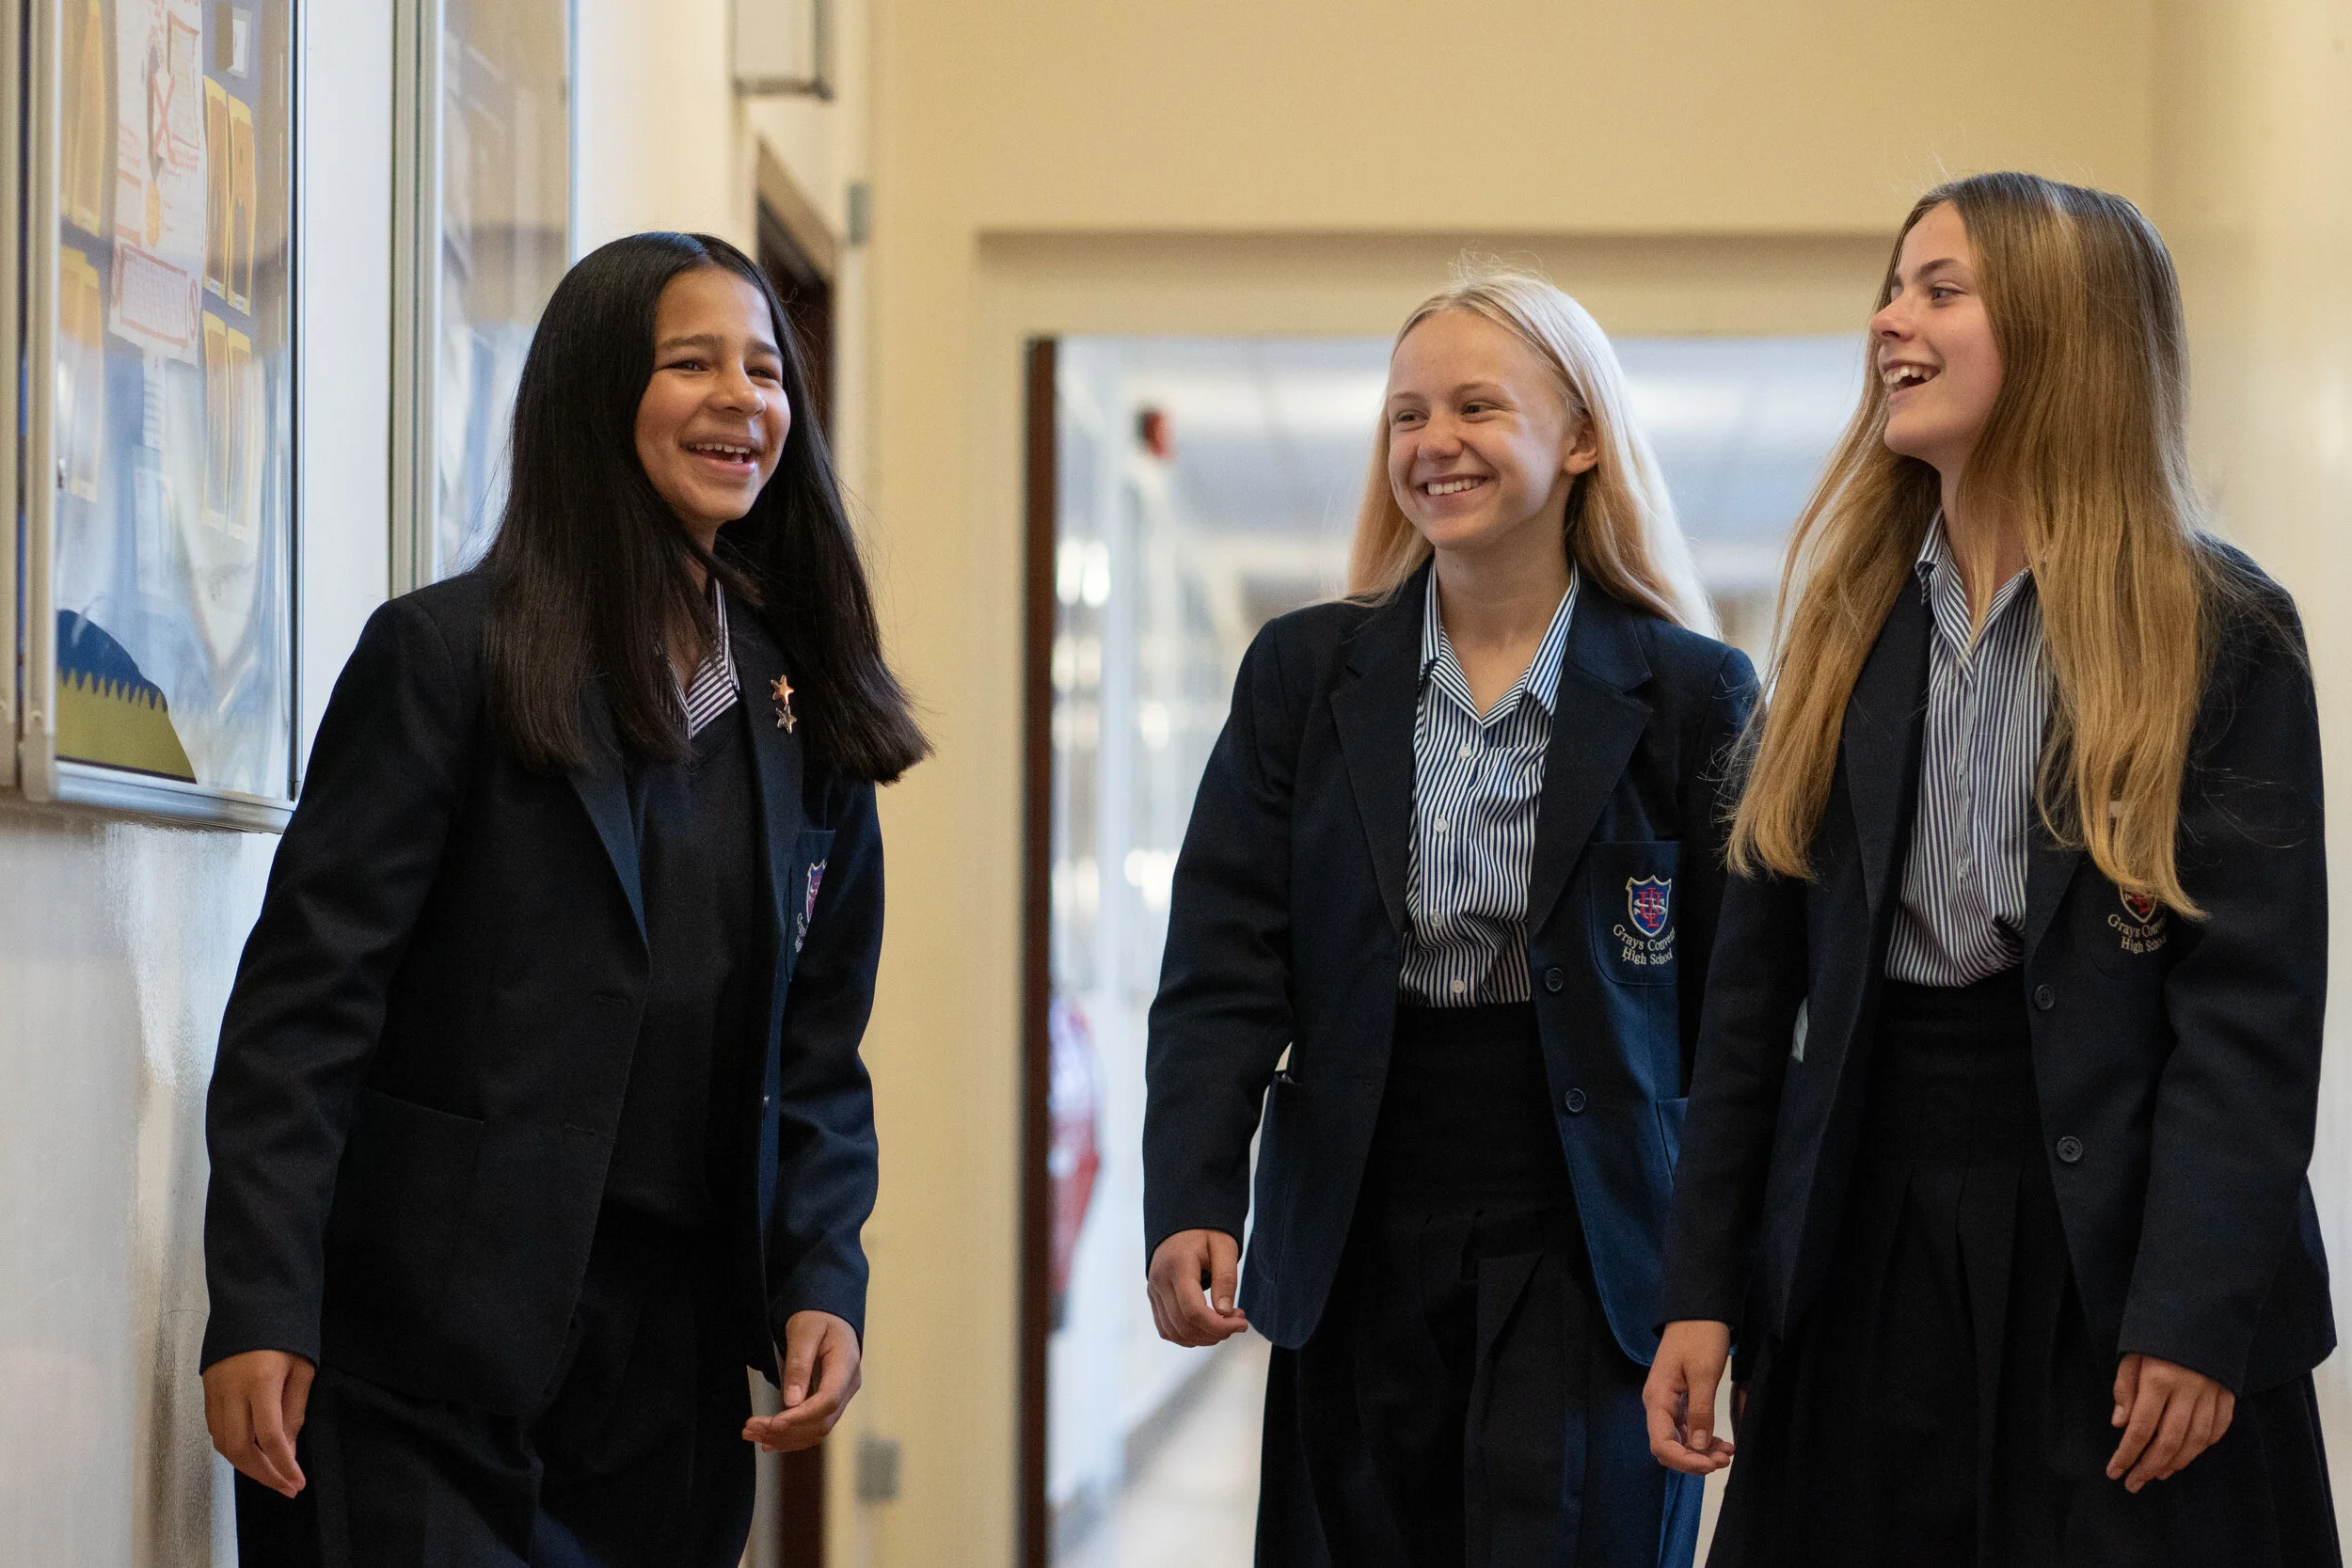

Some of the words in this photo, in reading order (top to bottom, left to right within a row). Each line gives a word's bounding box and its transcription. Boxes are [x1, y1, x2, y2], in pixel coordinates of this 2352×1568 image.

[2107, 913, 2140, 938] Grays
[2141, 916, 2167, 937] Conv
[1613, 924, 1645, 951] Grays
[2121, 936, 2144, 954] High
[1622, 946, 1646, 965] High
[1649, 947, 1673, 965] School
